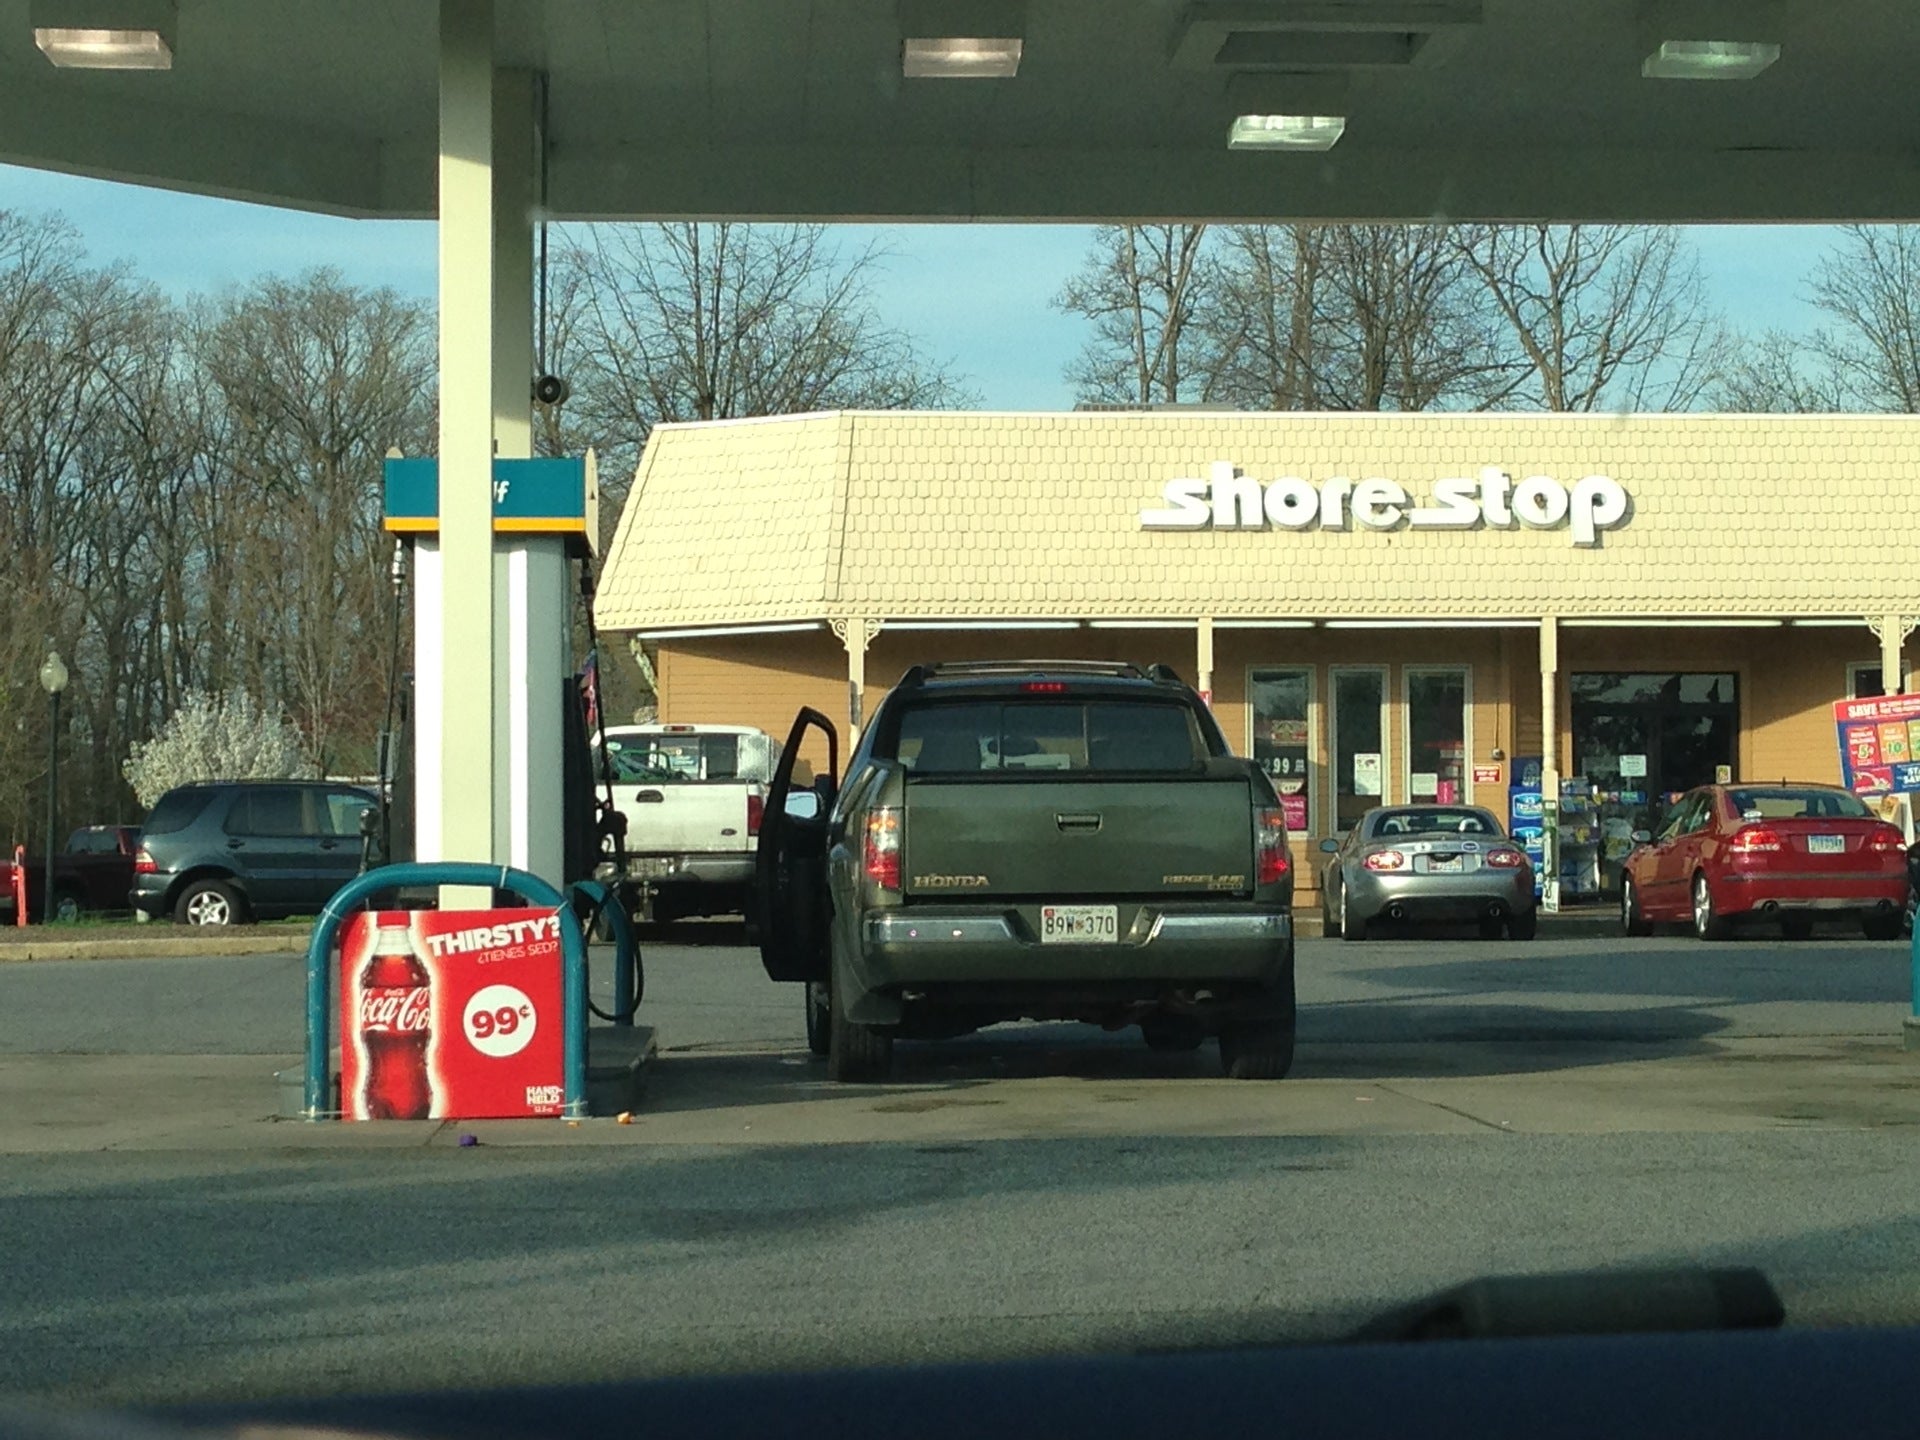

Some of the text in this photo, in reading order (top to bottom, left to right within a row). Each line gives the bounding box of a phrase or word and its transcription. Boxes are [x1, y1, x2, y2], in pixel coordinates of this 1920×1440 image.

[1140, 459, 1629, 548] shore stop
[913, 874, 990, 888] HONDA
[1085, 915, 1115, 935] 370
[427, 916, 560, 956] THIRSTY?
[526, 940, 559, 956] SED?
